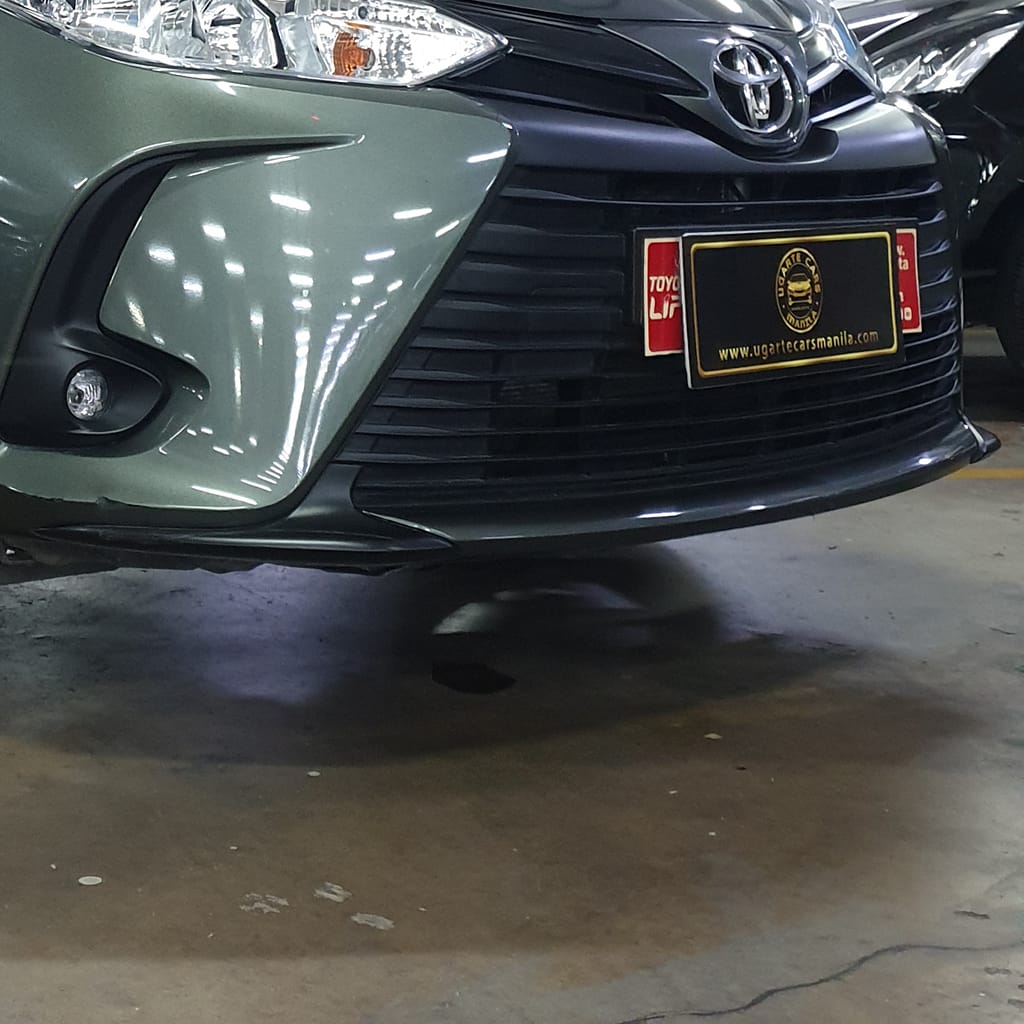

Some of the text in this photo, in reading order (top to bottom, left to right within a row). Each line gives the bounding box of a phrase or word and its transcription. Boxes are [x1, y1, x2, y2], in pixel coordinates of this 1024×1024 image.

[649, 275, 681, 293] TOYO
[778, 252, 822, 297] UGARTE CARS
[718, 330, 880, 361] www.ugartecarsmanila.com
